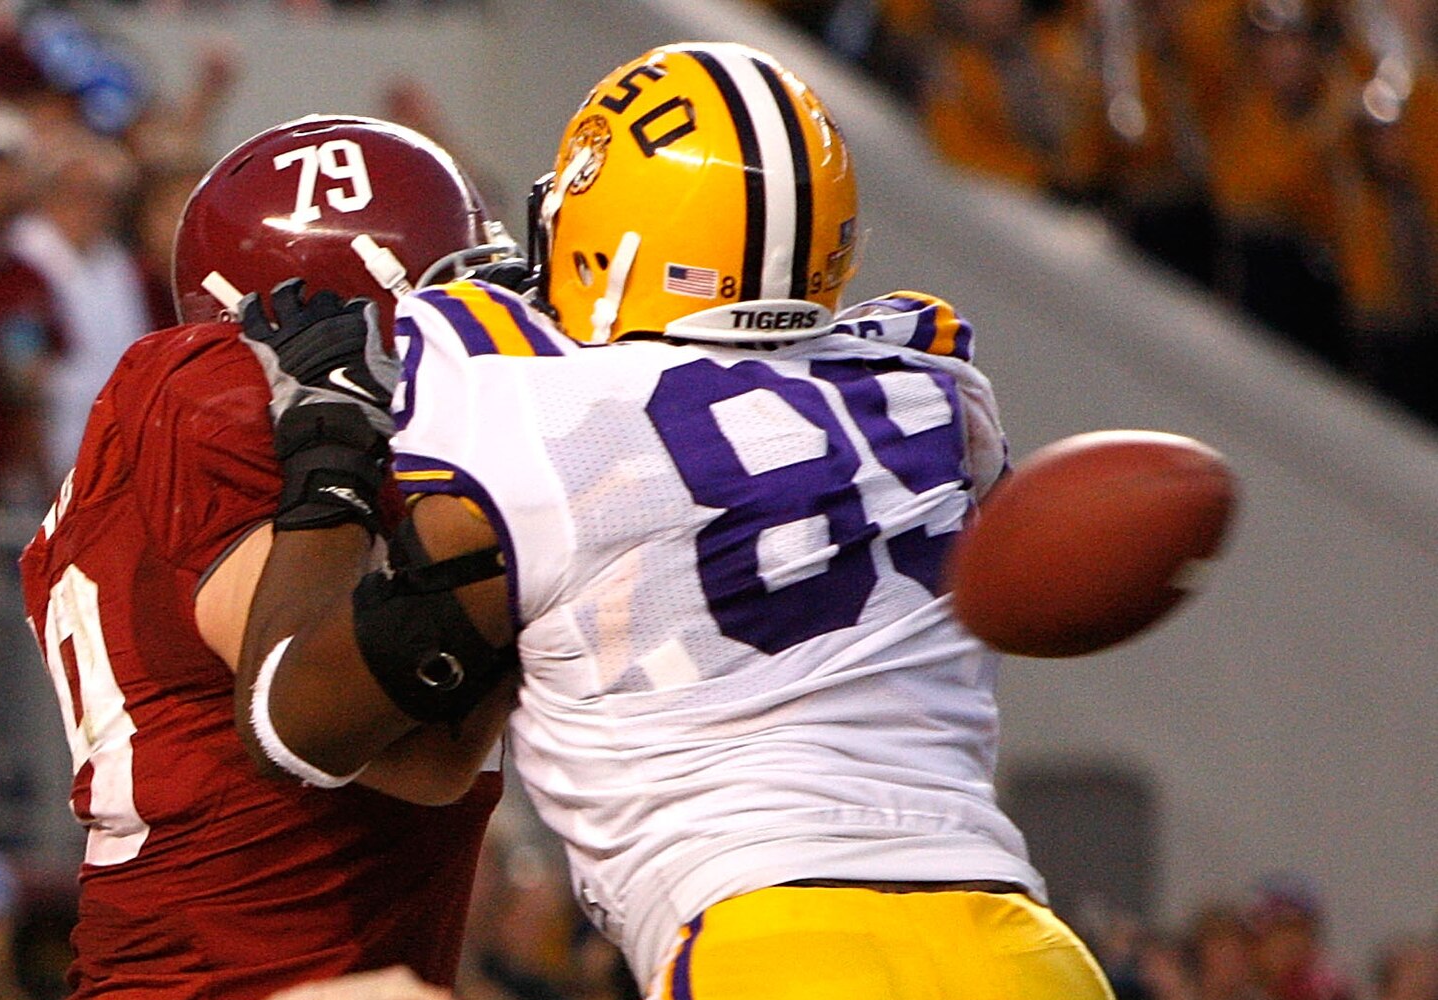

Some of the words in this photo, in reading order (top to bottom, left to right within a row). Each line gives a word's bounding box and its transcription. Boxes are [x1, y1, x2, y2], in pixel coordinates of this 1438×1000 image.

[273, 138, 373, 225] 79
[720, 276, 736, 298] 8
[730, 309, 820, 330] TIGERS
